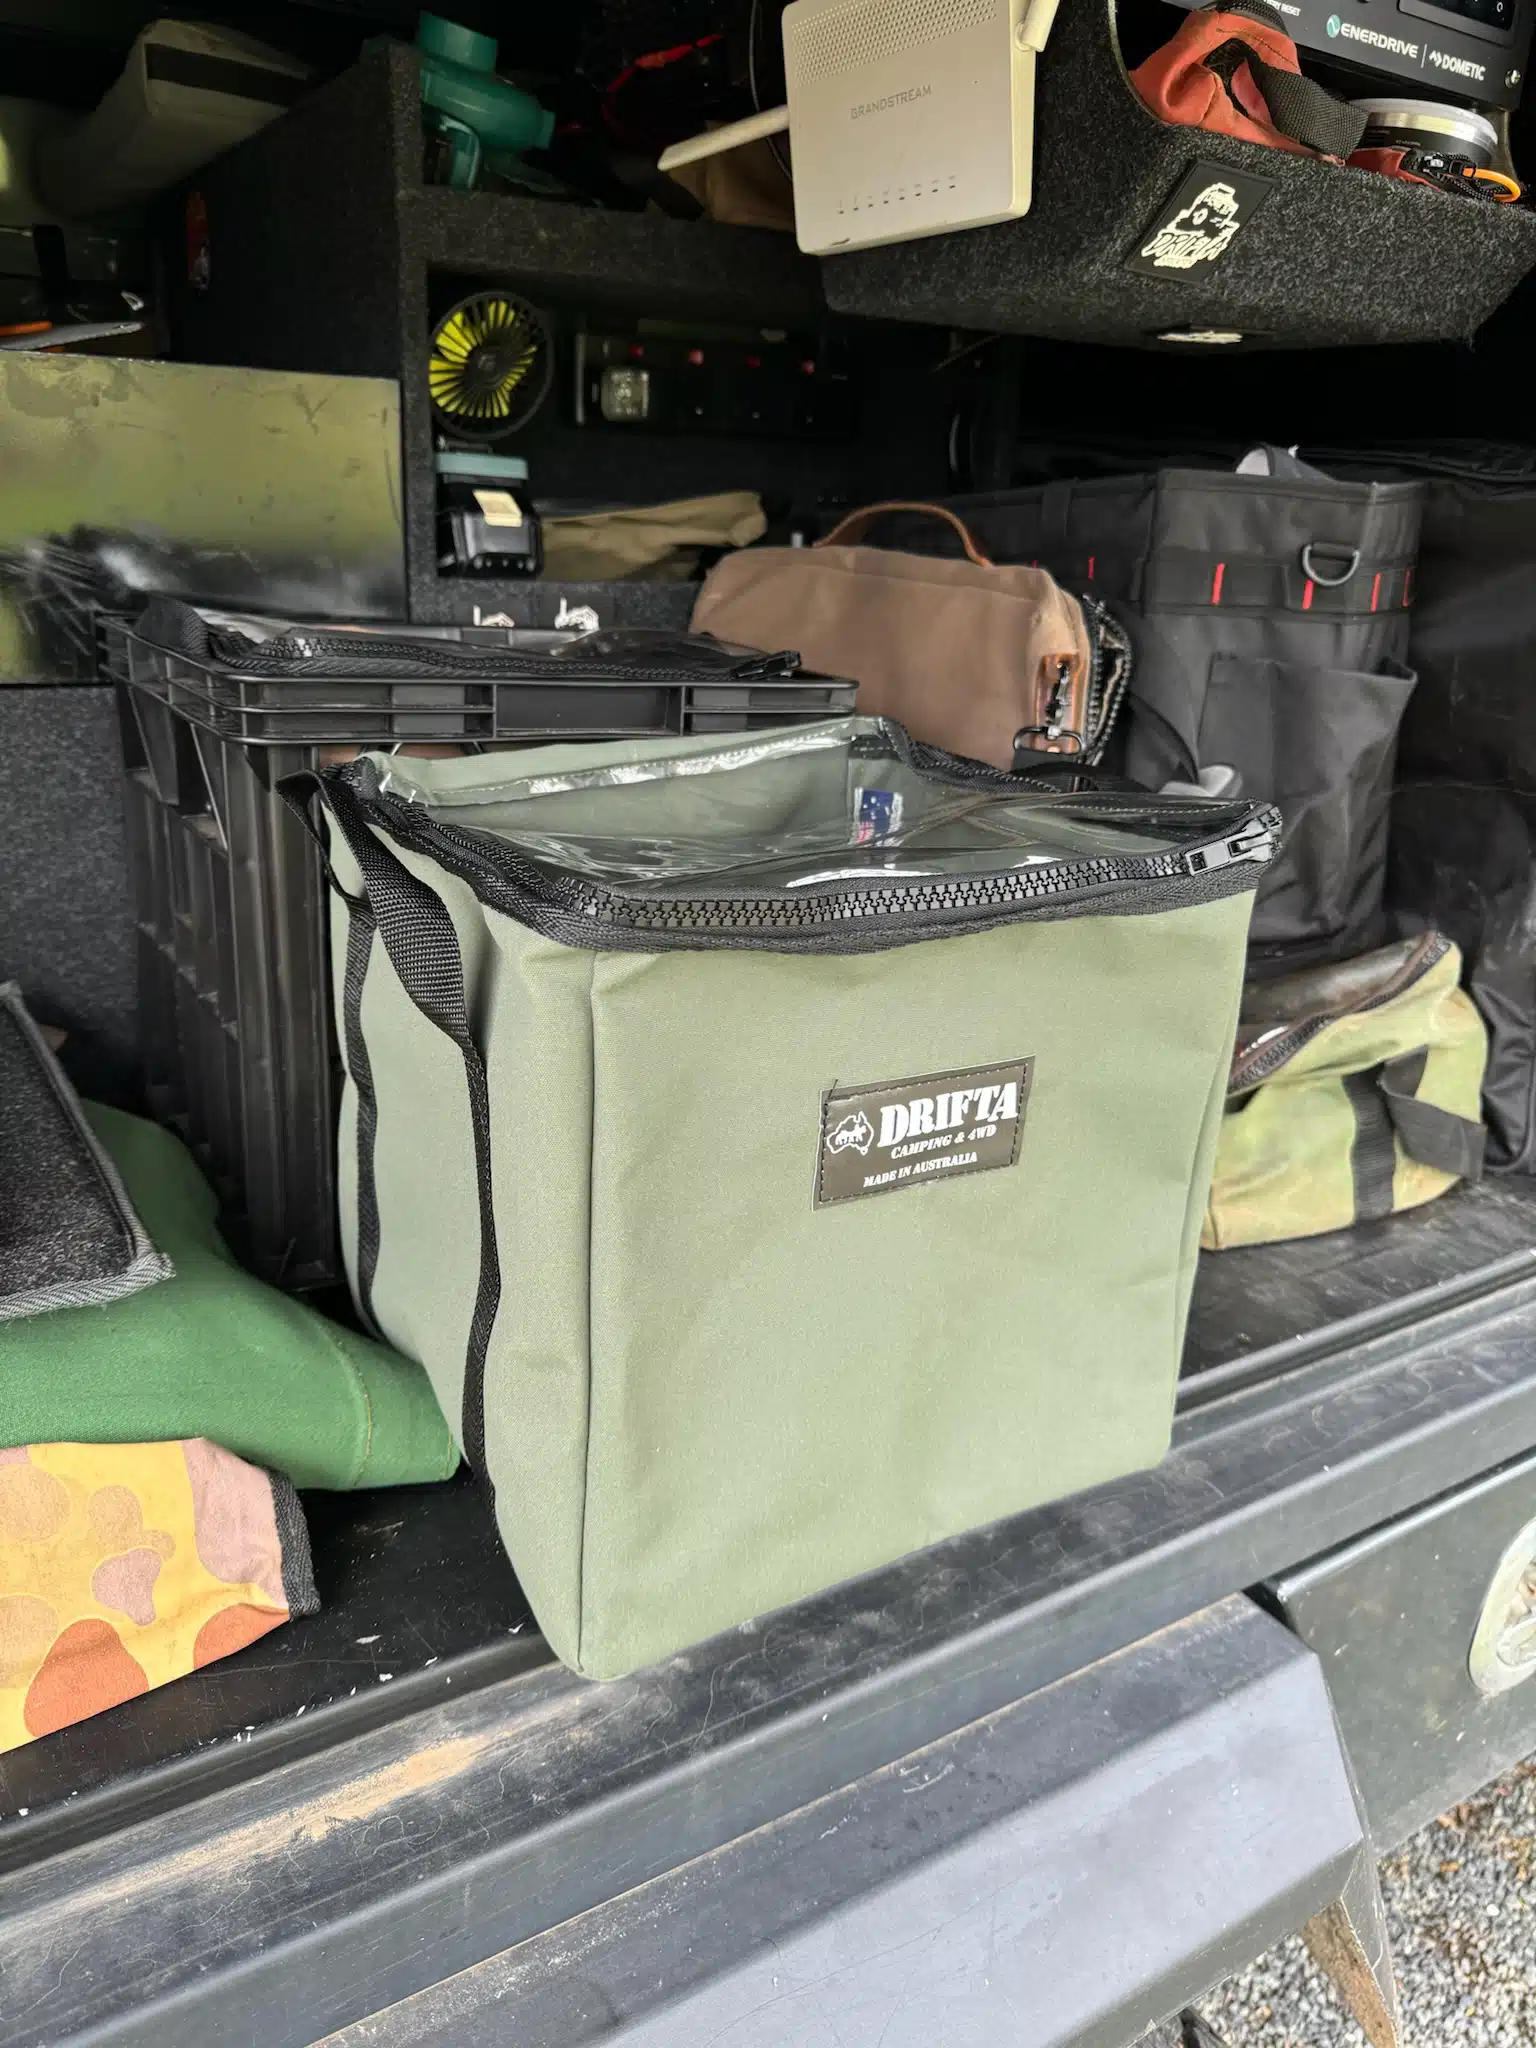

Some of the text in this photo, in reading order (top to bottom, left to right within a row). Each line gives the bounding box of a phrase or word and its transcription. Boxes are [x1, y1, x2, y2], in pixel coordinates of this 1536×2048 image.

[1341, 23, 1487, 81] ENERDRIVE DOMETIC
[850, 84, 932, 120] GRANDSTREAM
[877, 1082, 1018, 1147] DRIFTA
[891, 1124, 997, 1160] CAMPING & 4WD
[863, 1152, 978, 1188] MADE IN AUSTRALIA
